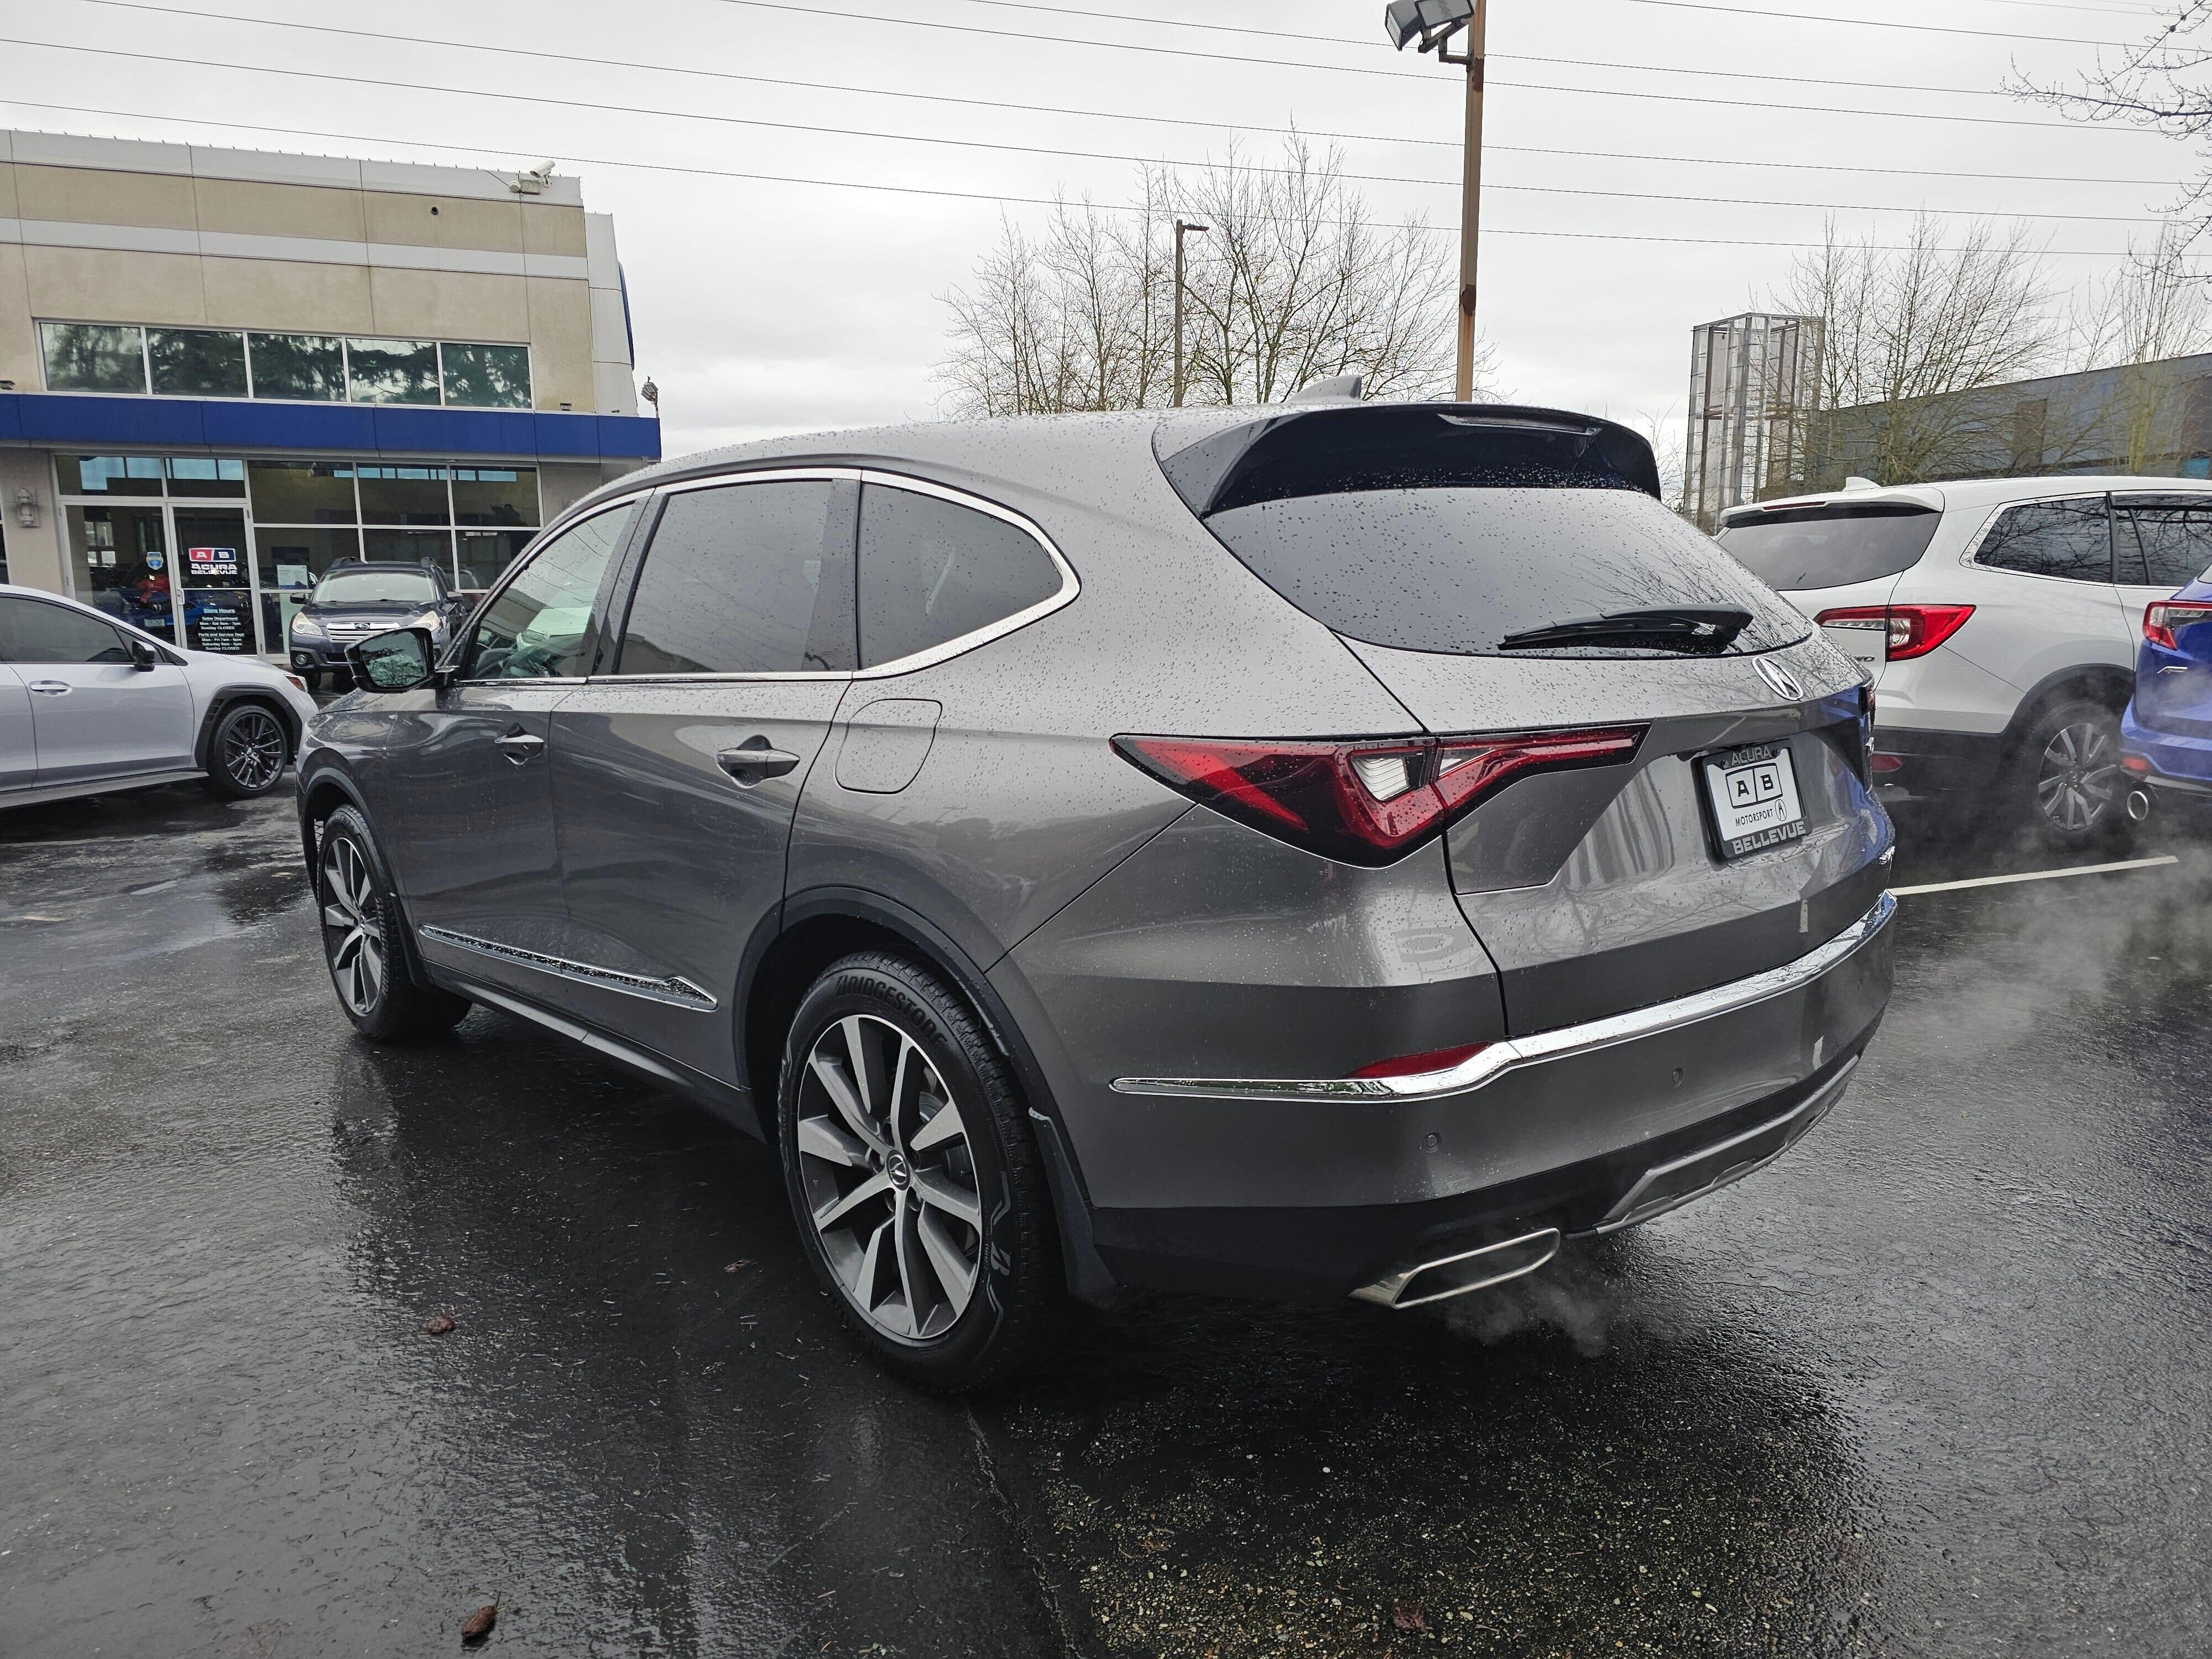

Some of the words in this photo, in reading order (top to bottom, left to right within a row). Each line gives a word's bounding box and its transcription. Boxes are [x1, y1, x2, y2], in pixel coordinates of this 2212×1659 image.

[1731, 745, 1772, 766] ACURA
[1735, 808, 1774, 827] MOTORSPORT
[1731, 821, 1806, 855] BELLEVUE
[835, 974, 948, 1046] BRIDGESTONE
